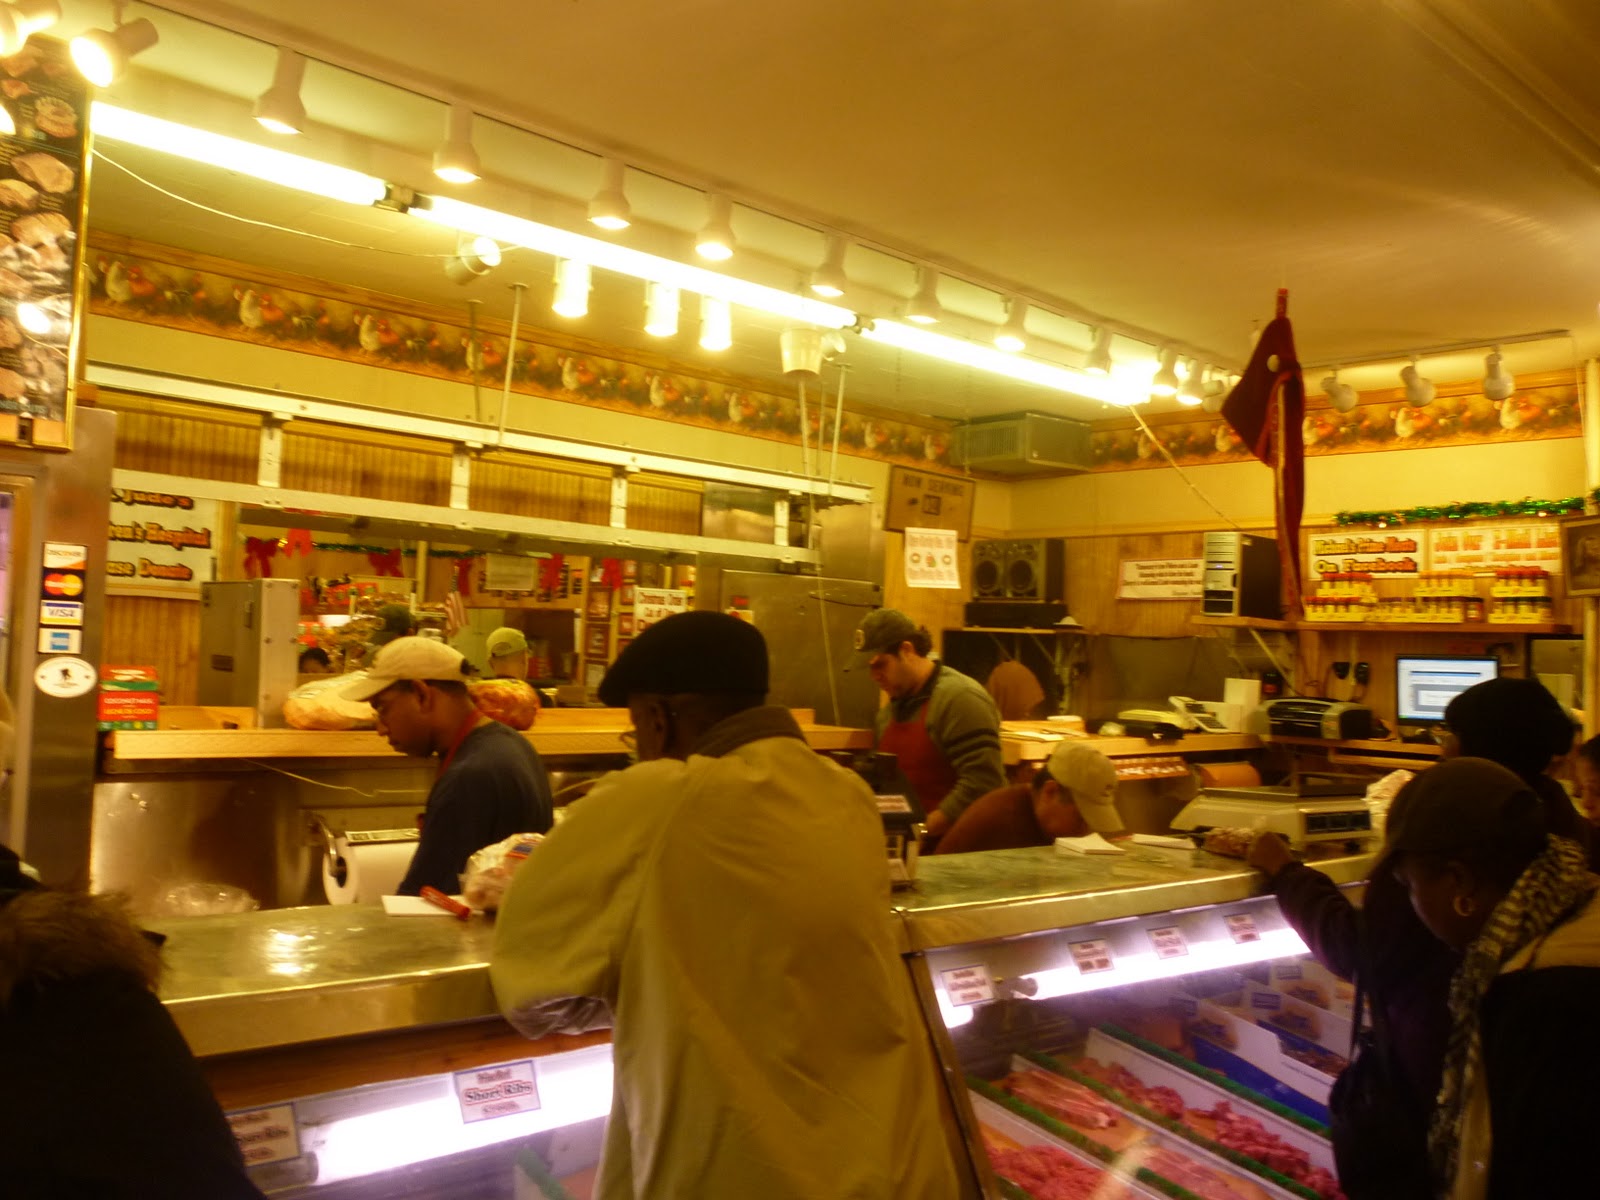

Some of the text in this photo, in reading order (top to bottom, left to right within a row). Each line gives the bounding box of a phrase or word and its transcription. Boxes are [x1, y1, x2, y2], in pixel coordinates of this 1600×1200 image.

[903, 474, 964, 497] NOW SERVING
[145, 522, 211, 551] Hospital
[139, 557, 193, 581] Donate
[1314, 559, 1339, 574] On
[1342, 556, 1418, 573] Facebook
[48, 608, 76, 618] VISA
[463, 1081, 534, 1105] Short Ribs
